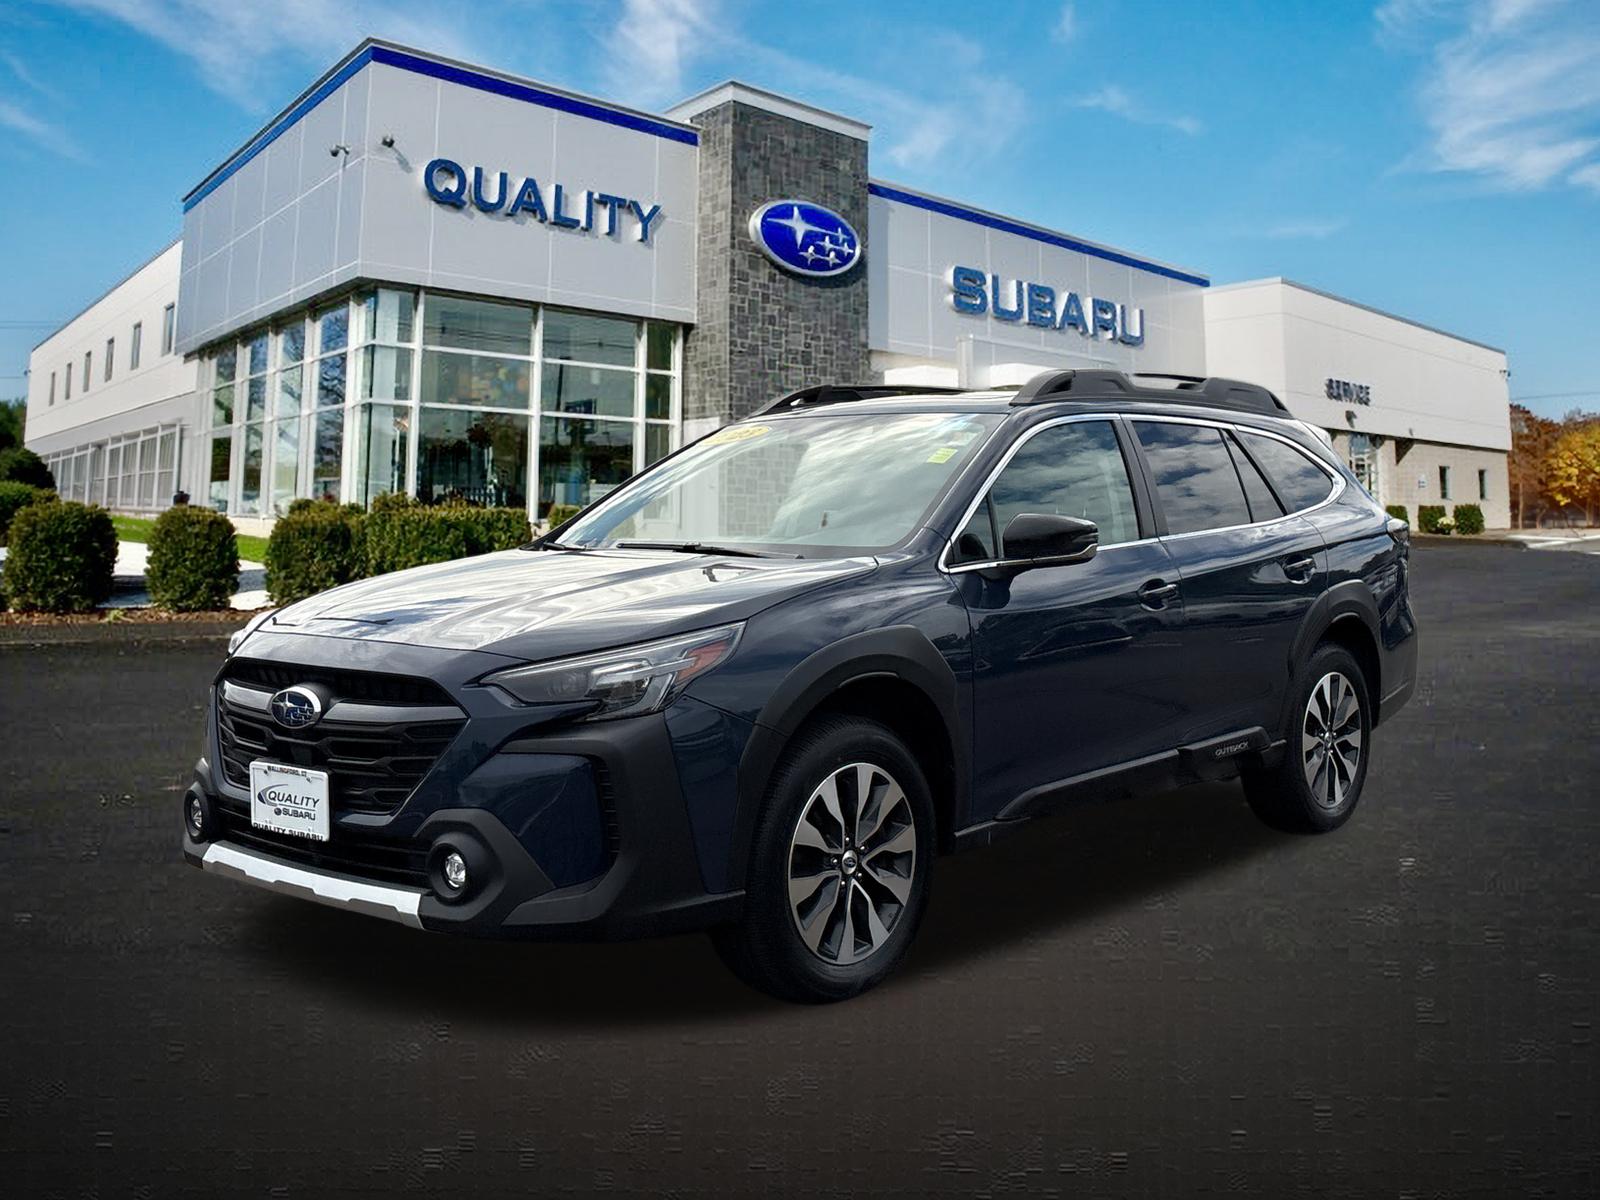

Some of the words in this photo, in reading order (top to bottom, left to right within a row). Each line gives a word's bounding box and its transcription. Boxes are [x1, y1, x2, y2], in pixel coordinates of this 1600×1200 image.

[424, 158, 661, 242] QUALITY
[951, 265, 1144, 346] SUBARU
[1325, 378, 1371, 406] SERVICE
[1216, 741, 1248, 756] OUTBACK
[268, 790, 320, 808] QUALITY
[282, 808, 316, 821] SUBARU
[253, 822, 286, 834] QUALITY
[288, 829, 323, 841] SUBARU
